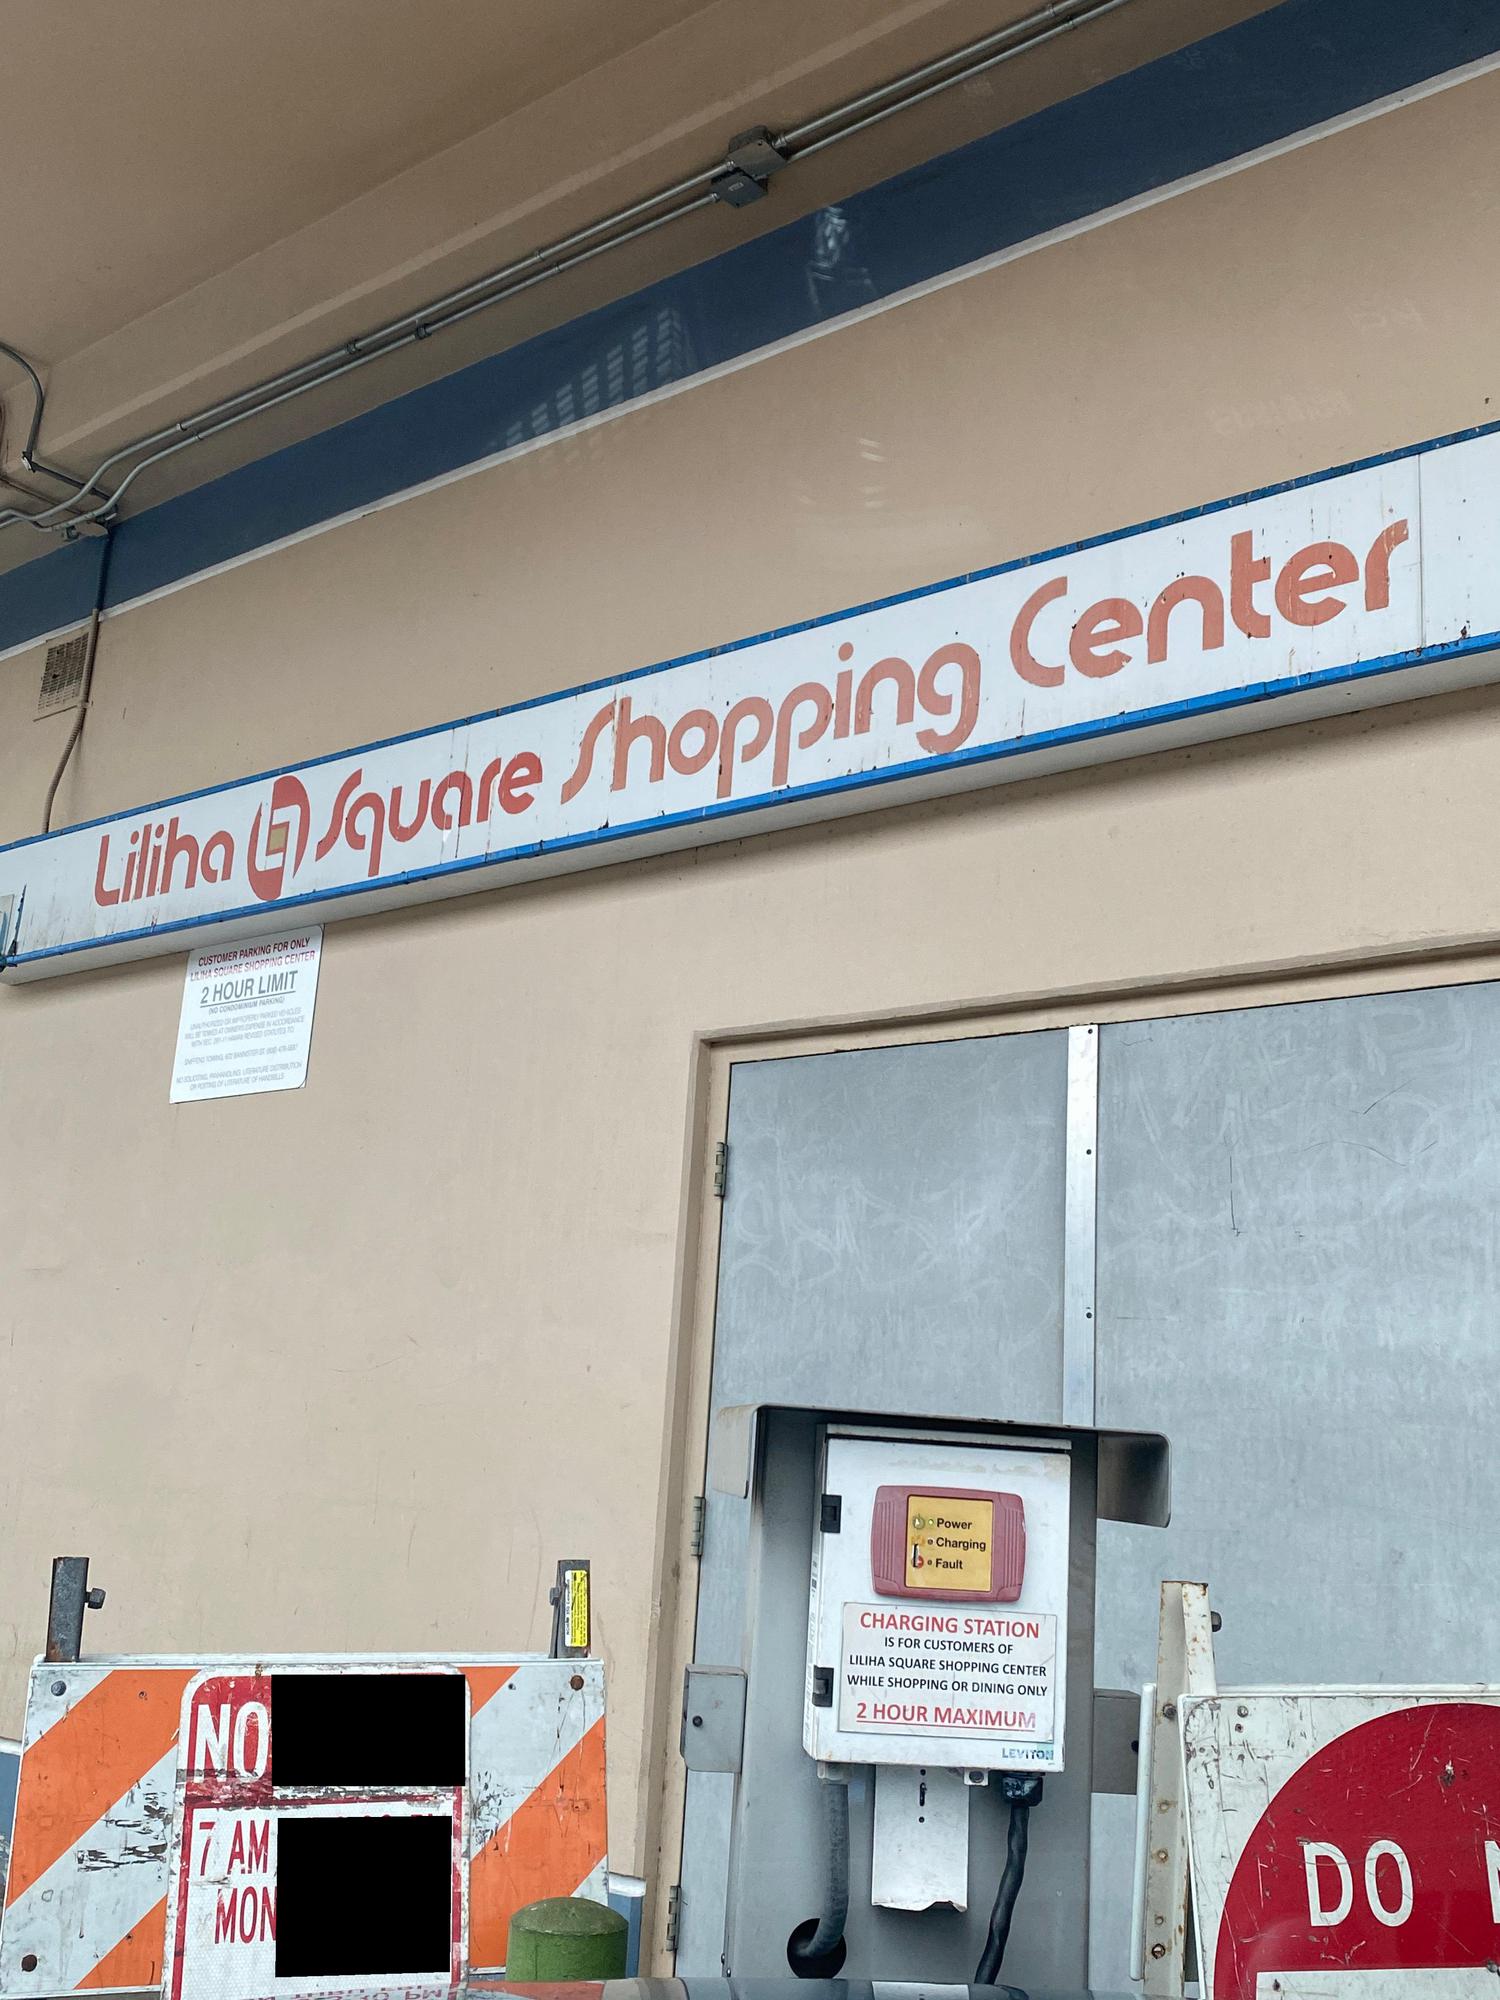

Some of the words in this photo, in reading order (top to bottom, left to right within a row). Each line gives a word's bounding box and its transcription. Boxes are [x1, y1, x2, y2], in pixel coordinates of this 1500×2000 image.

[94, 816, 235, 906] Liliha
[315, 751, 543, 877] Square
[560, 641, 981, 799] Shopping
[1010, 518, 1409, 688] Center
[190, 969, 212, 981] LILIHA
[213, 963, 243, 977] SQUARE
[244, 956, 283, 972] SHOPPING
[284, 950, 316, 964] CENTER
[198, 951, 238, 967] CUSTOMER
[239, 945, 271, 959] PARKING
[273, 941, 289, 953] FOR
[290, 937, 310, 950] ONLY
[200, 986, 209, 1004] 2
[212, 978, 255, 1002] HOUR
[258, 970, 298, 995] LIMIT
[936, 1518, 972, 1530] Power
[936, 1537, 986, 1552] Charging
[935, 1558, 963, 1570] Fault
[860, 1612, 958, 1633] CHARGING
[963, 1618, 1039, 1638] STATION
[884, 1636, 895, 1648] IS
[898, 1637, 921, 1649] FOR
[924, 1639, 995, 1654] CUSTOMERS
[998, 1643, 1014, 1655] OF
[849, 1654, 885, 1667] LILIHA
[888, 1657, 936, 1670] SQUARE
[939, 1660, 999, 1674] SHOPPING
[1002, 1663, 1047, 1677] CENTER
[847, 1674, 884, 1687] WHILE
[887, 1677, 948, 1691] SHOPPING
[951, 1680, 968, 1692] OR
[972, 1682, 1014, 1695] DINING
[1017, 1685, 1048, 1697] ONLY
[856, 1702, 867, 1719] 2
[873, 1703, 928, 1722] HOUR
[934, 1707, 1036, 1729] MAXIMUM
[194, 1701, 270, 1783] NO
[1002, 1748, 1053, 1760] LEVITON
[199, 1821, 217, 1876] 7
[227, 1819, 270, 1875] AM
[1302, 1839, 1414, 1928] DO
[214, 1886, 278, 1945] MON
